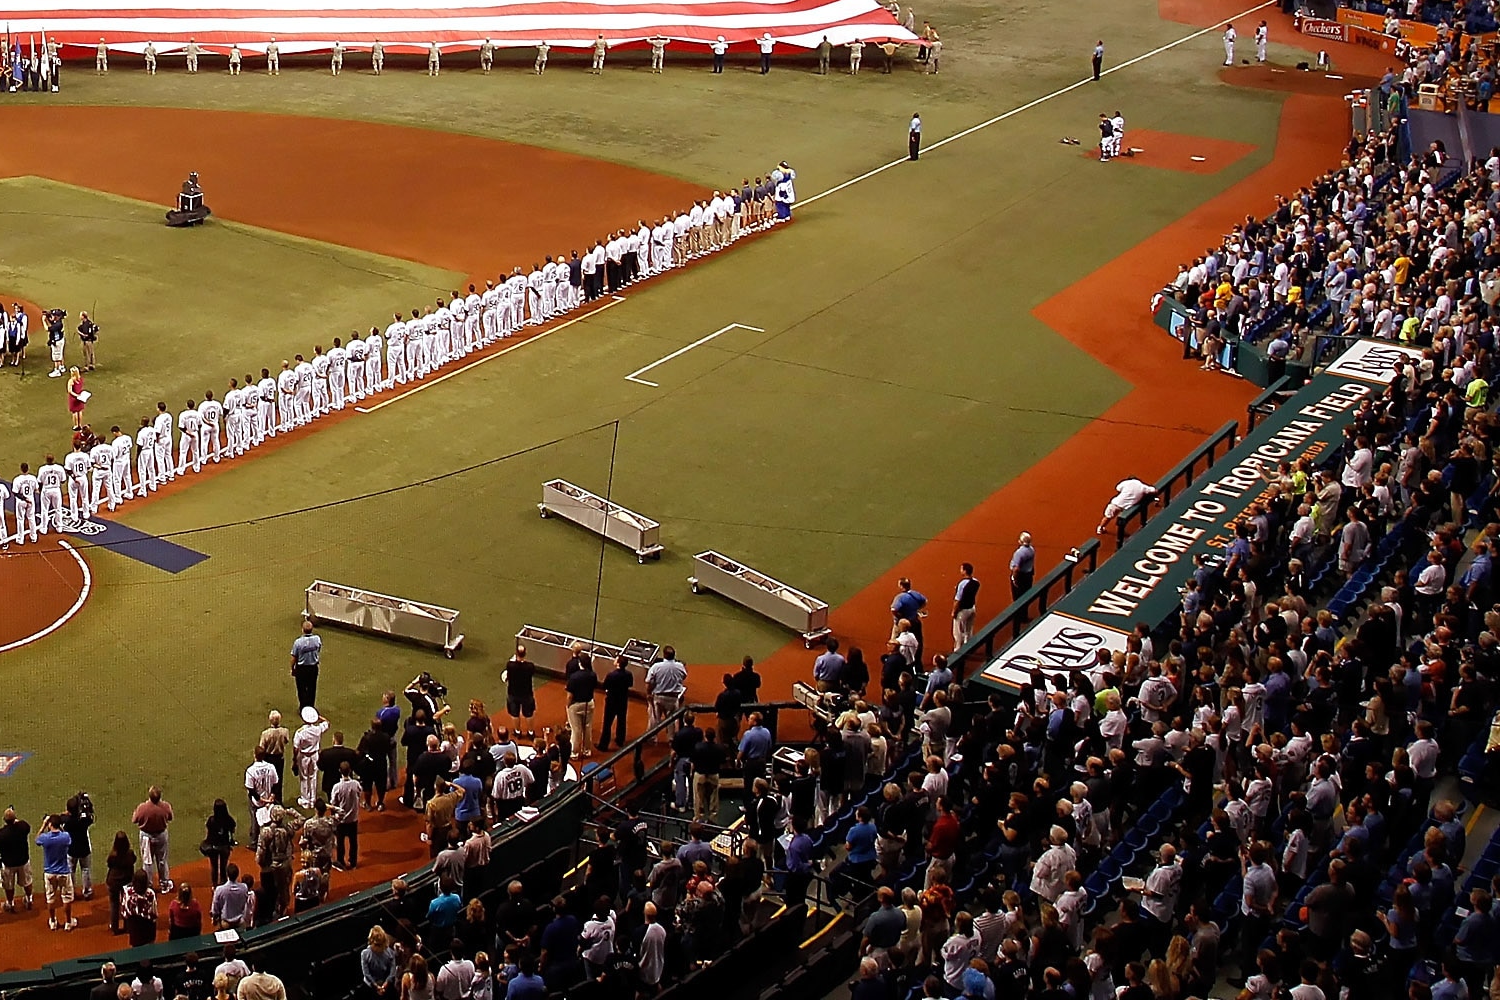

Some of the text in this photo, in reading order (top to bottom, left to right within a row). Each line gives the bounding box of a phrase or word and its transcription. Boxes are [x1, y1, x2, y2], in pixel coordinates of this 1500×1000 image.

[1304, 20, 1342, 35] Checkers
[1337, 345, 1404, 377] RAYS
[74, 462, 85, 473] 18
[47, 475, 57, 486] 13
[24, 485, 30, 496] 8
[1087, 382, 1372, 617] WELCOME TO TROPICANA FIELD
[999, 626, 1104, 680] RAYS
